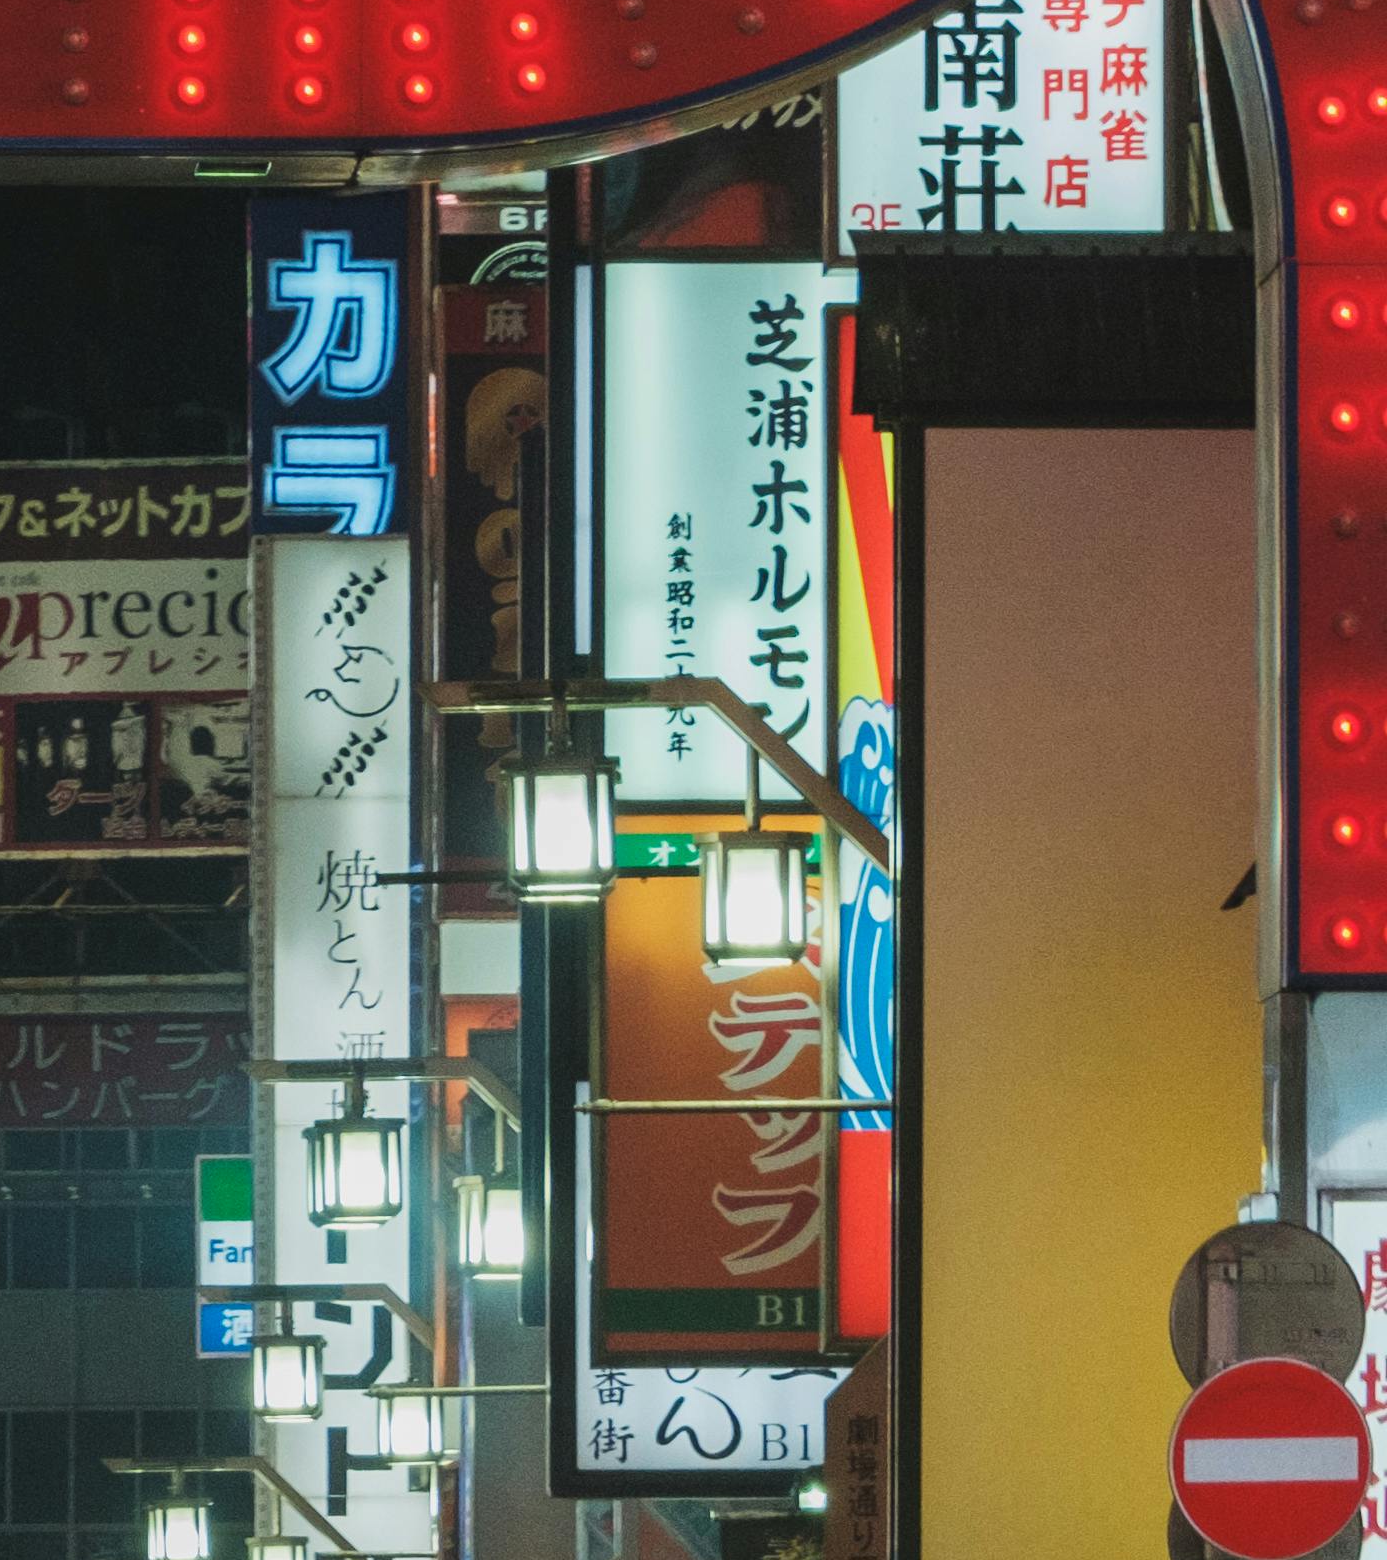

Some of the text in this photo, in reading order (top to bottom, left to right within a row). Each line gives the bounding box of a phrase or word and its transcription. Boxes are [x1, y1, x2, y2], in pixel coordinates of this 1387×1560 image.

[744, 292, 816, 745] 芝浦ホルモン
[756, 1293, 808, 1327] B1
[760, 1421, 813, 1463] B1
